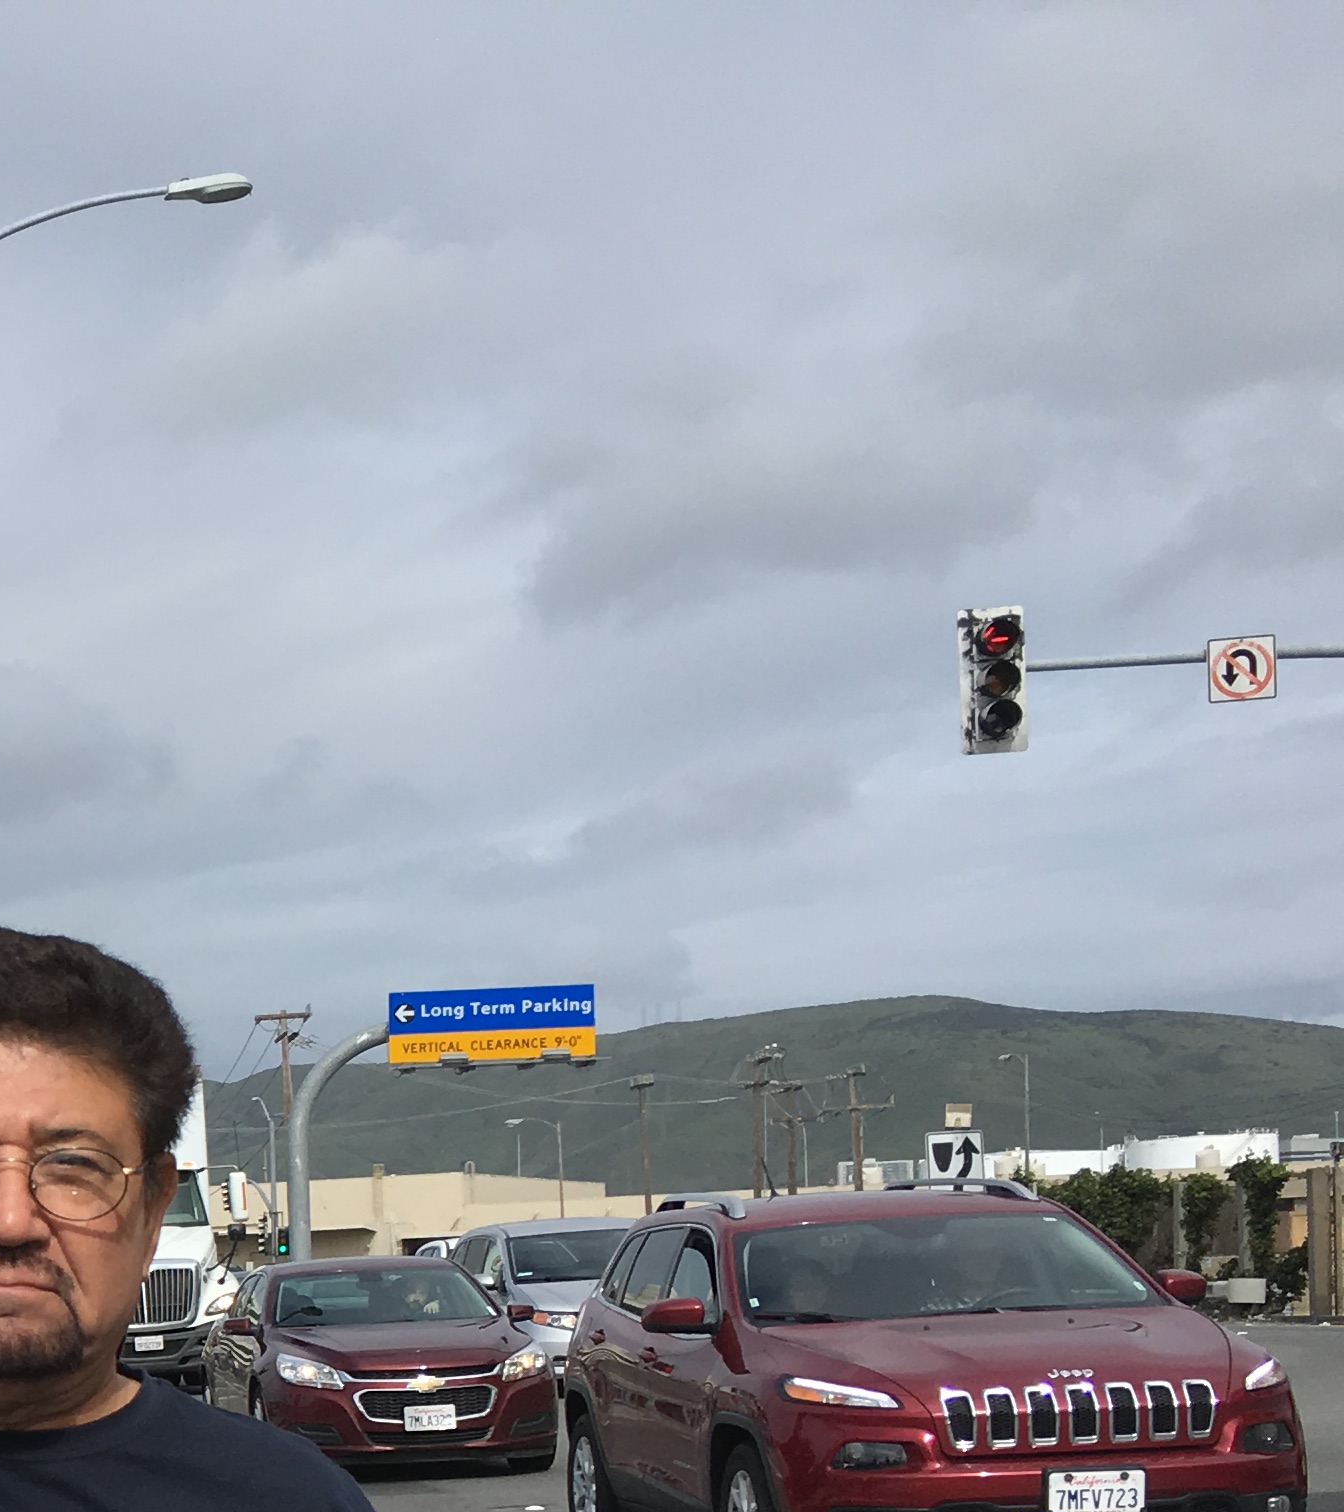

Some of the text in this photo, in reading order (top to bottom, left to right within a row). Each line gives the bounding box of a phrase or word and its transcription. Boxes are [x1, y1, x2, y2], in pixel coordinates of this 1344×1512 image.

[421, 997, 592, 1019] Long Term Parking
[402, 1040, 463, 1054] VERTICAL
[470, 1036, 547, 1051] CLEARANCE
[1056, 1488, 1138, 1511] 7MFV723
